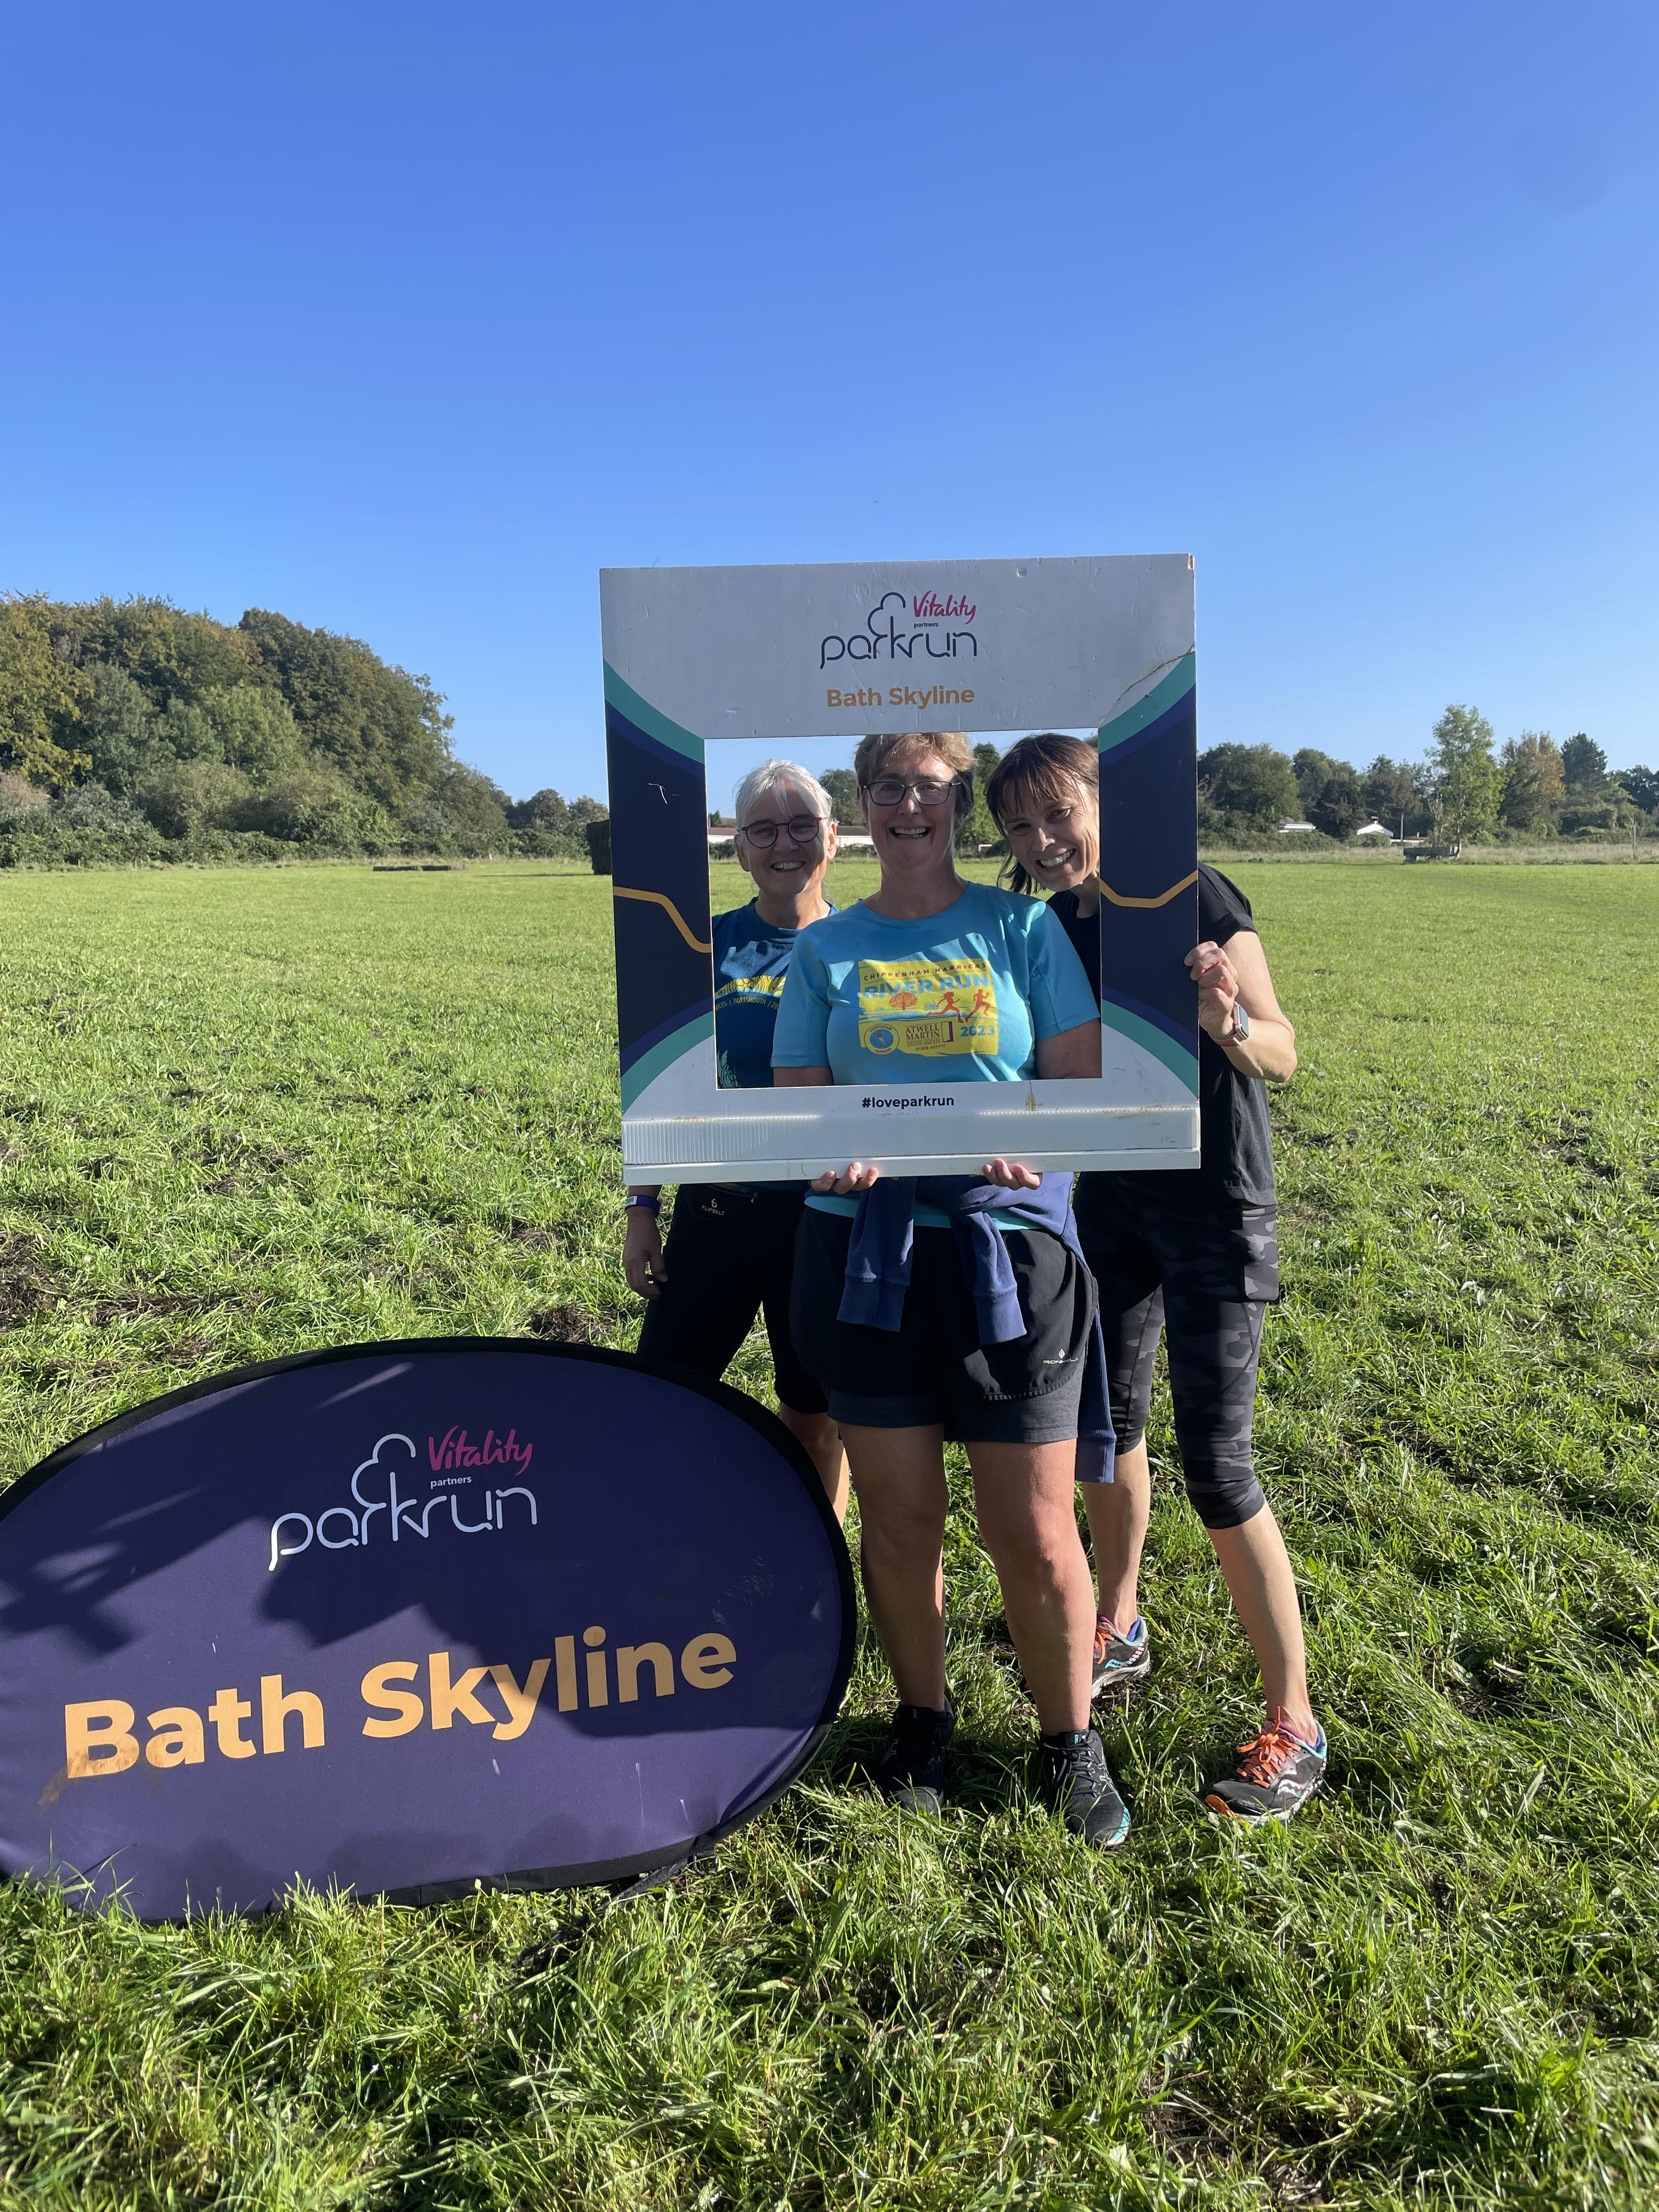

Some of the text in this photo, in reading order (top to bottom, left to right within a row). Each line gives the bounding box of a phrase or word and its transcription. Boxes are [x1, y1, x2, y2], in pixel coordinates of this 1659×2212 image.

[913, 590, 976, 624] Vitality
[820, 615, 977, 669] parkrun
[827, 685, 975, 709] Bath Skyline
[864, 963, 986, 981] CHIPPENHAM HARRIERS
[864, 973, 989, 998] RIVER RUN
[906, 1024, 939, 1034] ATWELL
[906, 1031, 940, 1041] MARTIN
[960, 1025, 995, 1037] 2023
[862, 1096, 954, 1109] #loveparkrun
[702, 1205, 724, 1216] FLIPBELT
[428, 1425, 533, 1476] Vitality
[430, 1476, 472, 1489] partners
[268, 1471, 537, 1571] parkrun
[65, 1626, 737, 1779] Bath Skyline
